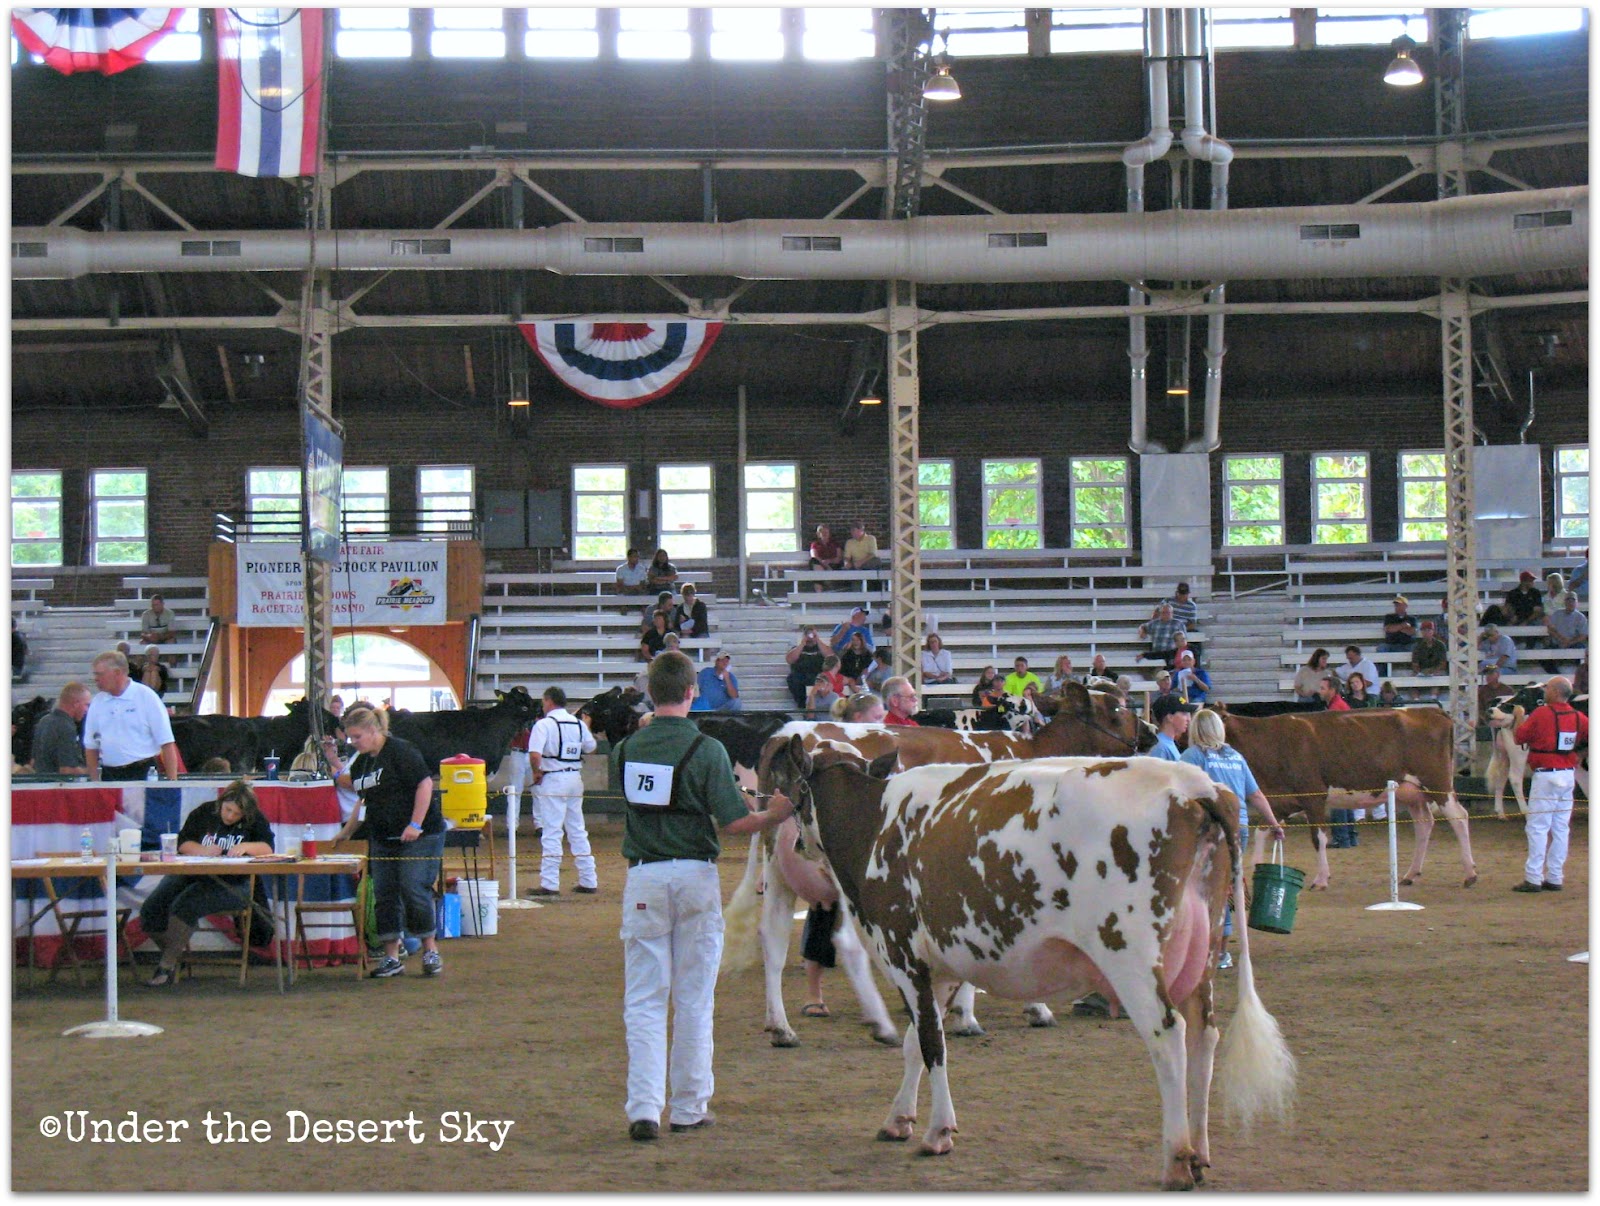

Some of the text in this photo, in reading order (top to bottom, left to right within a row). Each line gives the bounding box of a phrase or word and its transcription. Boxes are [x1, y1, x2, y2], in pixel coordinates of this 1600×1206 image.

[340, 546, 384, 555] ATE FAIR
[246, 561, 439, 573] PIONEER STOCK PAVILION
[261, 591, 304, 600] PRAIRIE
[637, 774, 654, 792] 75
